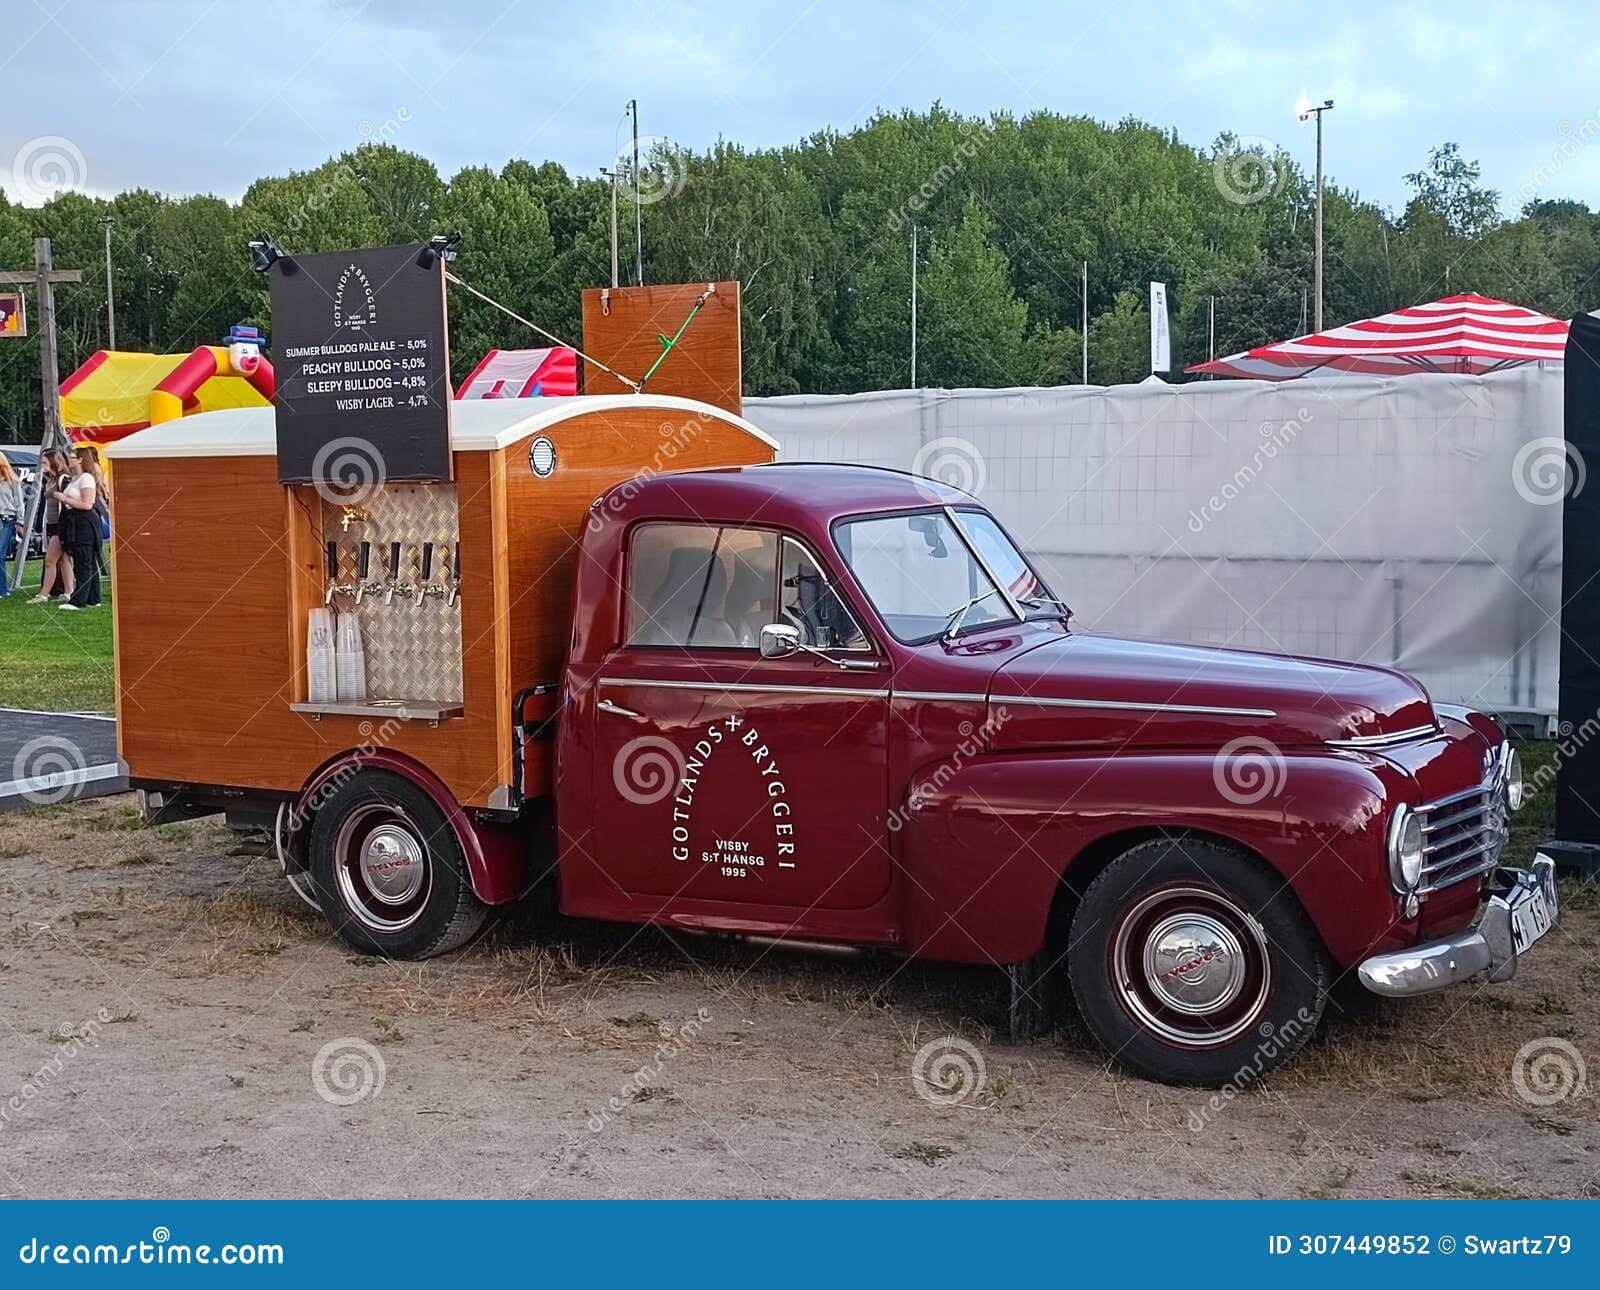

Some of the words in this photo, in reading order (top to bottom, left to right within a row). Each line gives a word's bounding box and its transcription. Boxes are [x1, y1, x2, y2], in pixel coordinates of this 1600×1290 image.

[334, 269, 350, 327] GOTLANDS
[355, 268, 377, 324] BRYGGERI
[286, 346, 320, 358] SUMMER
[320, 343, 358, 355] BULLDOG
[359, 342, 379, 352] PALE
[380, 341, 395, 351] ALE
[407, 340, 427, 350] 5,0%
[303, 362, 342, 376] PEACHY
[344, 359, 391, 373] BULLDOG
[401, 357, 426, 370] 5,0%
[307, 380, 343, 393] SLEEPY
[345, 377, 392, 391] BULLDOG
[401, 376, 426, 389] 4,8%
[336, 398, 364, 410] WISBY
[365, 397, 394, 409] LAGER
[673, 726, 723, 861] GOTLANDS
[742, 728, 795, 868] BRYGGERI
[716, 840, 749, 851] VISBY
[702, 853, 720, 862] S:T
[724, 854, 764, 866] HANSG
[721, 867, 746, 877] 1995
